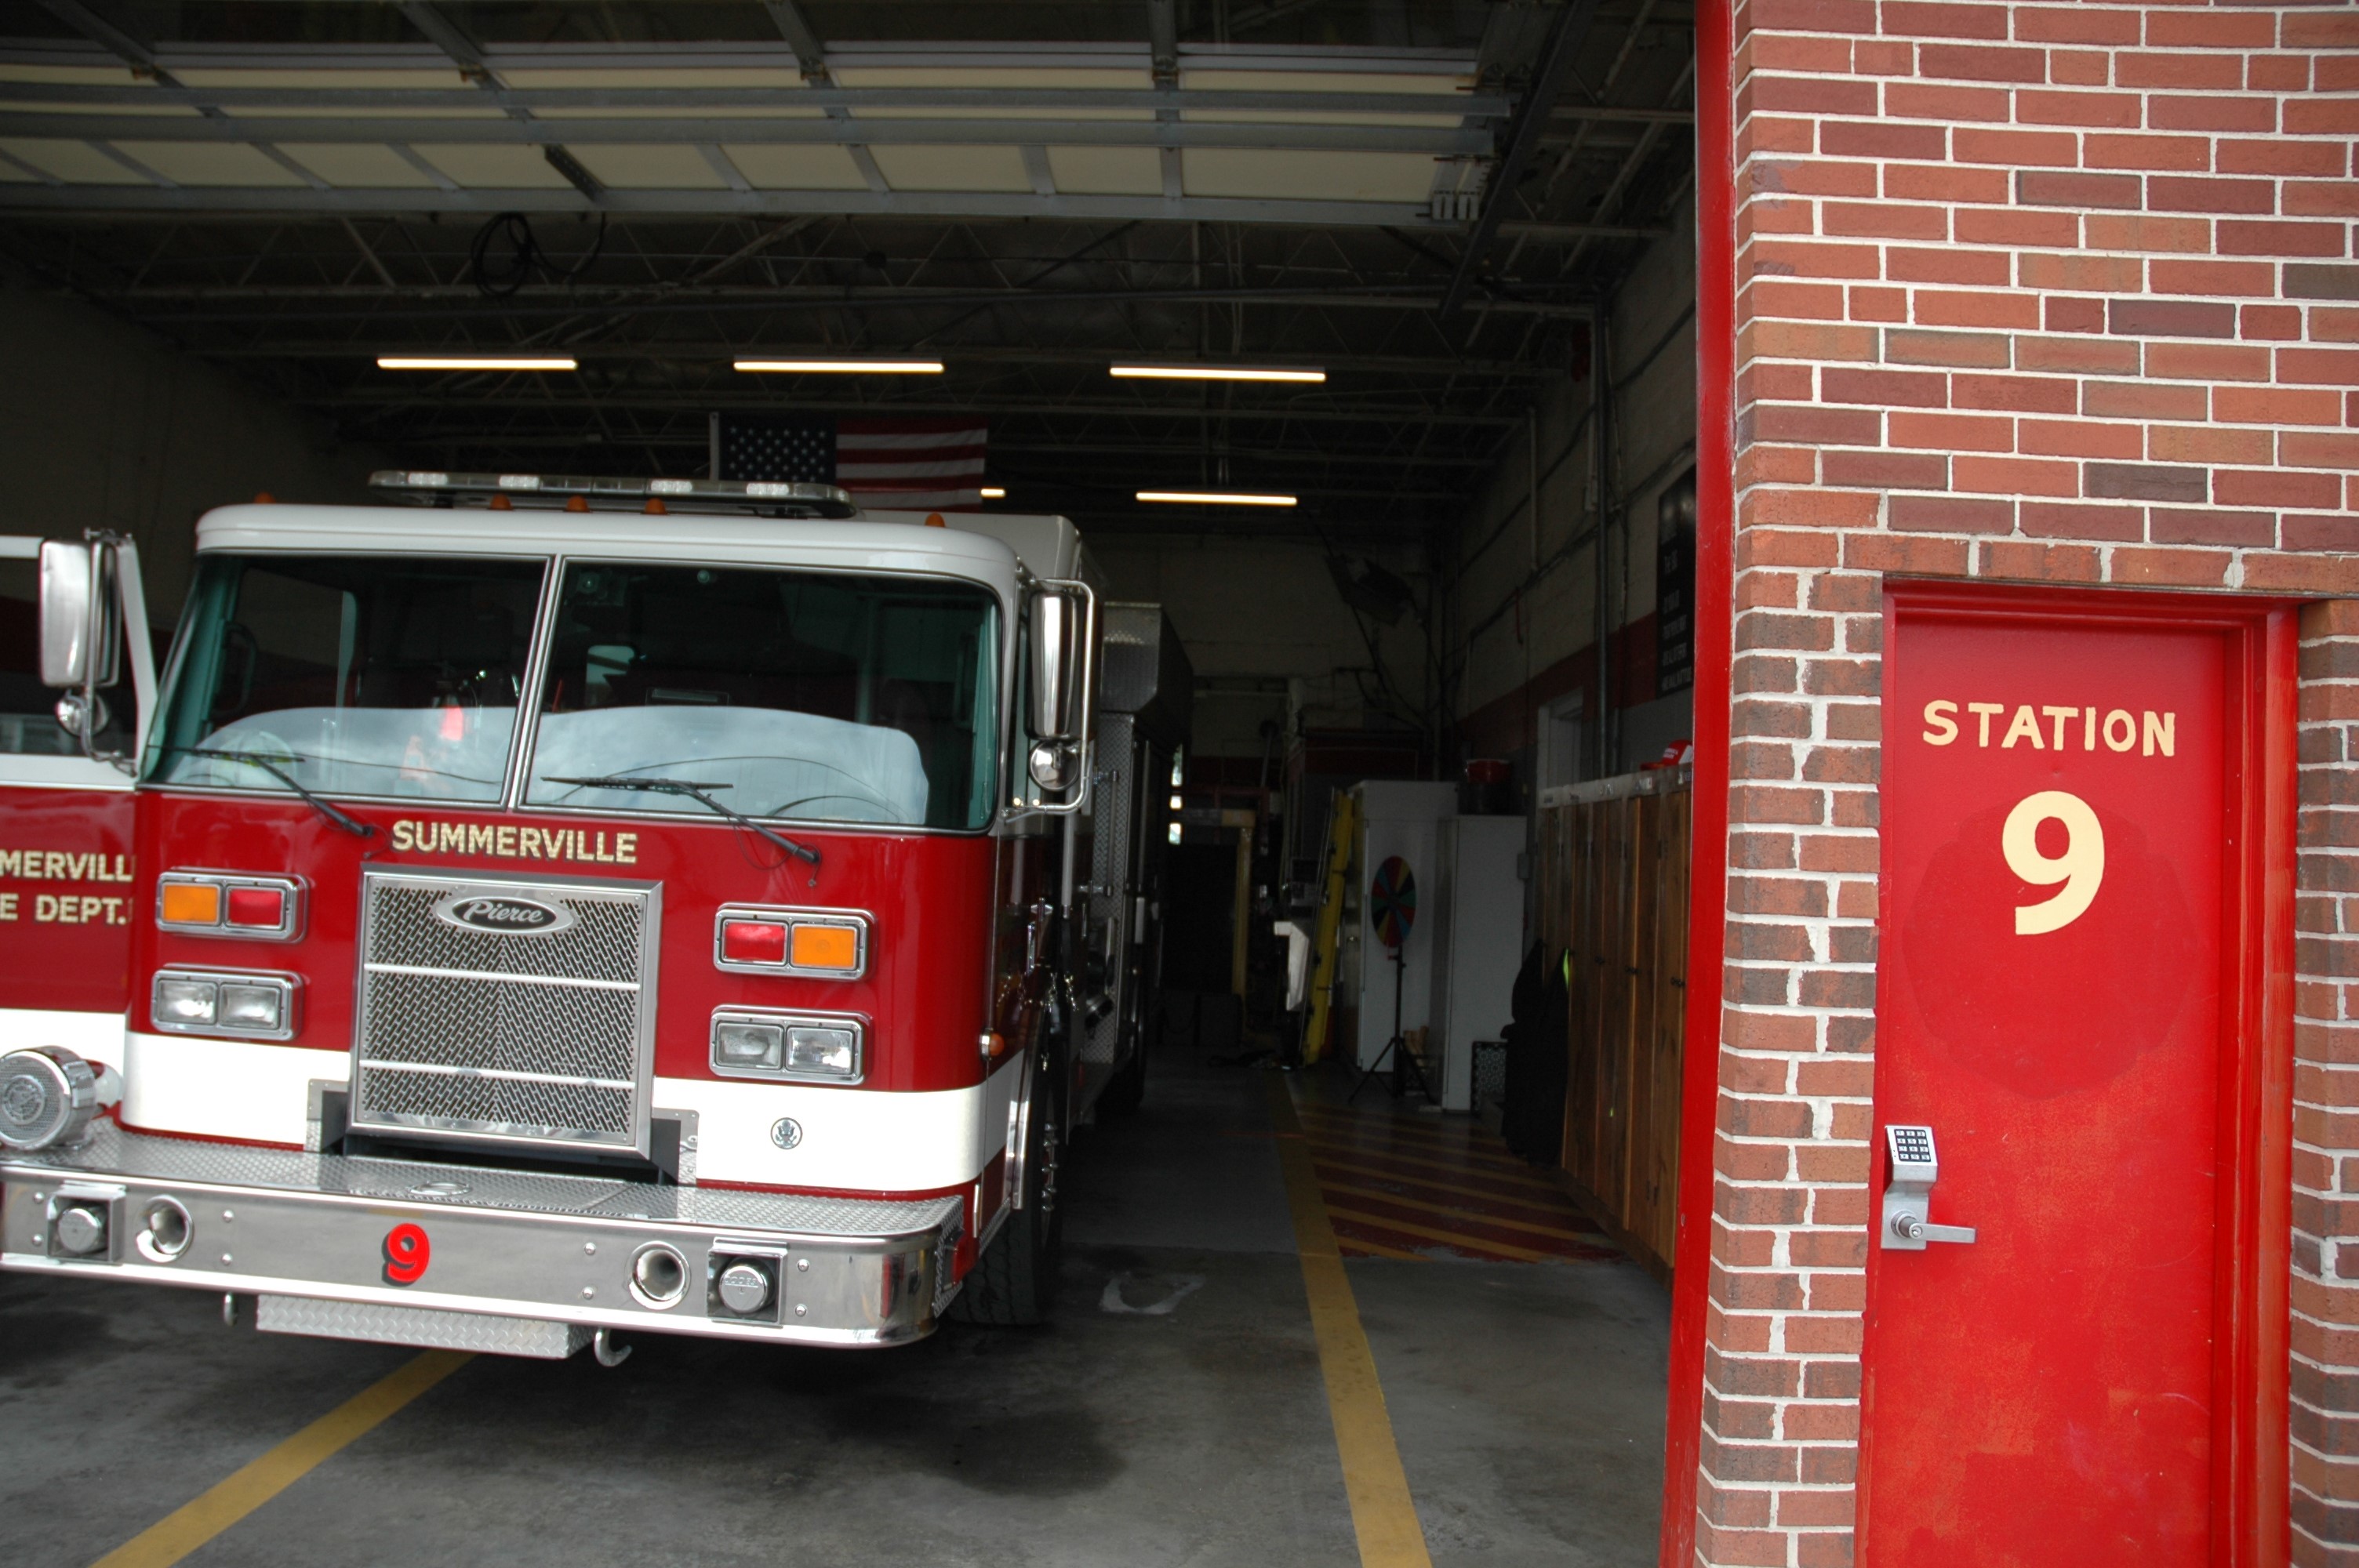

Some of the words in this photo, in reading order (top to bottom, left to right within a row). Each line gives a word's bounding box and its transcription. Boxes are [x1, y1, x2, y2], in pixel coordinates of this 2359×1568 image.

[1923, 699, 2175, 757] STATION
[392, 820, 638, 863] SUMMERVILLE
[2002, 790, 2105, 935] 9
[0, 849, 135, 882] MERVILL
[35, 895, 127, 924] DEPT.
[463, 900, 543, 924] Pierce
[385, 1222, 431, 1285] 9
